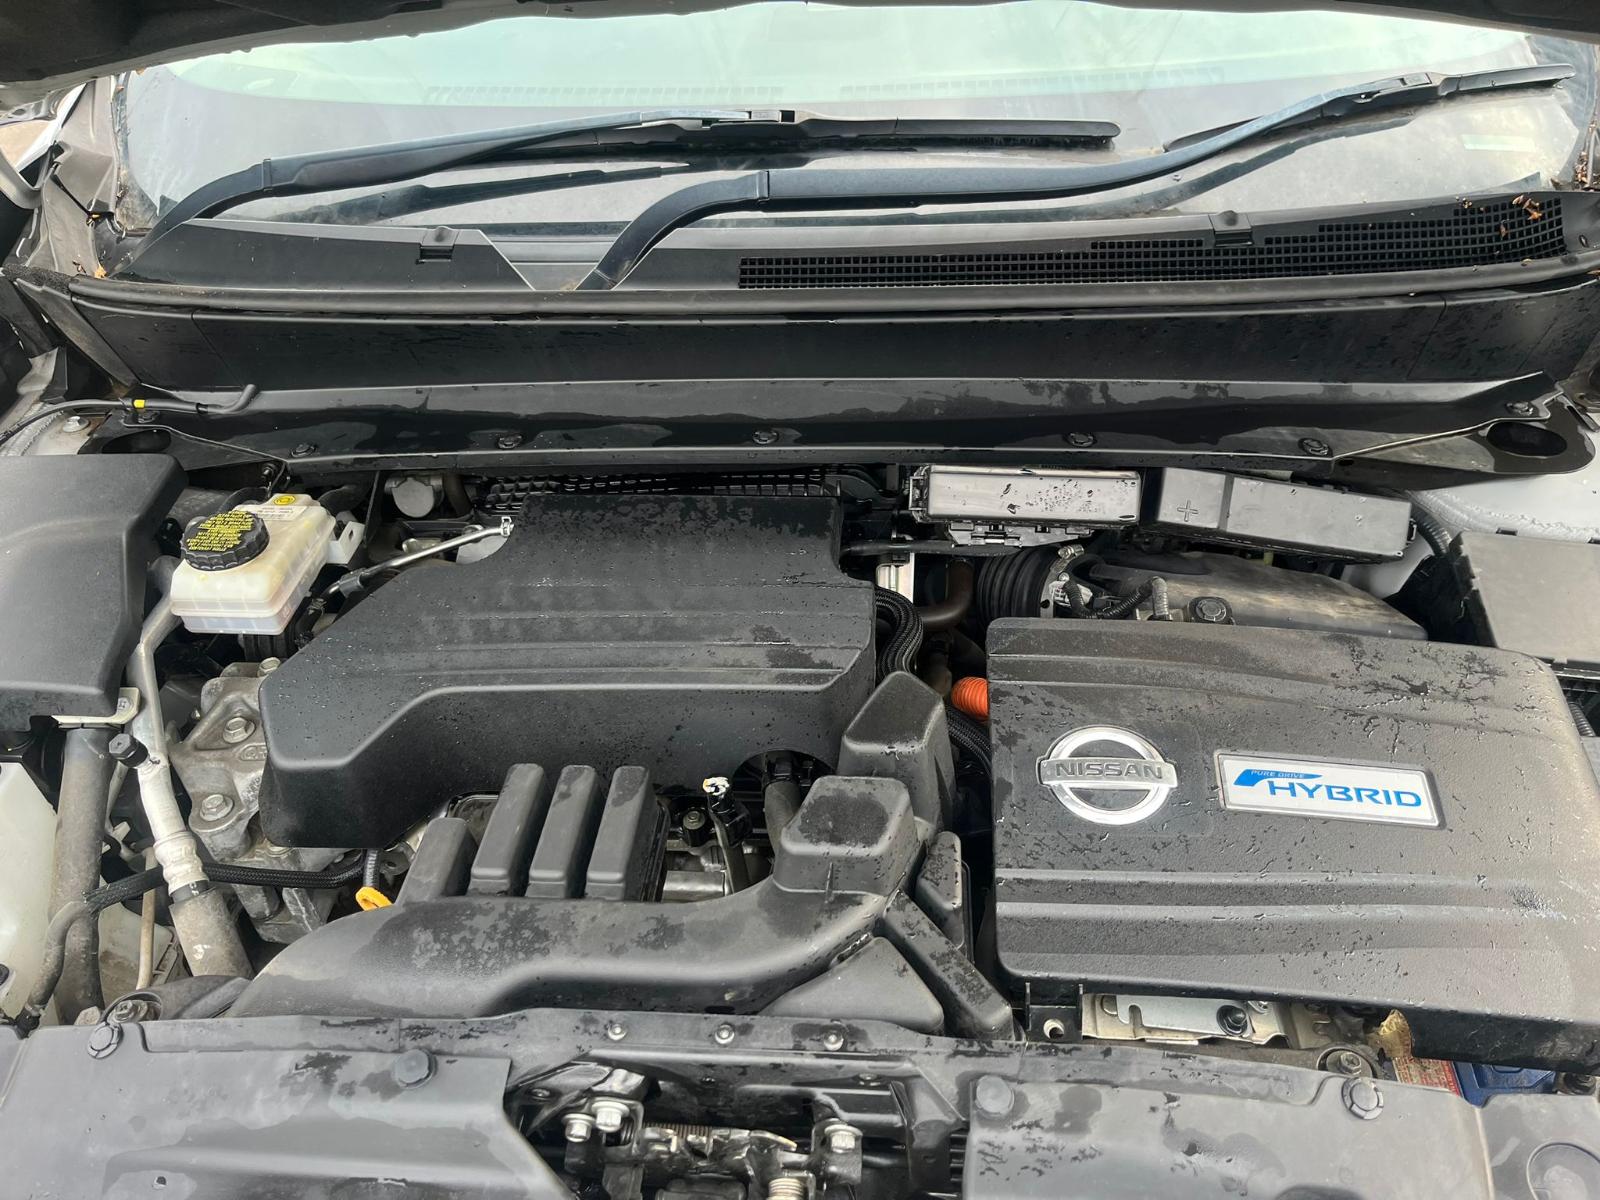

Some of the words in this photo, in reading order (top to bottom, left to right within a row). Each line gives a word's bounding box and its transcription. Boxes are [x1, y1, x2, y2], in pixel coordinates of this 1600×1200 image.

[1055, 762, 1163, 779] NISSAN
[1250, 769, 1276, 777] PURE
[1277, 771, 1305, 779] DRIVE
[1267, 780, 1422, 807] HYBRID
